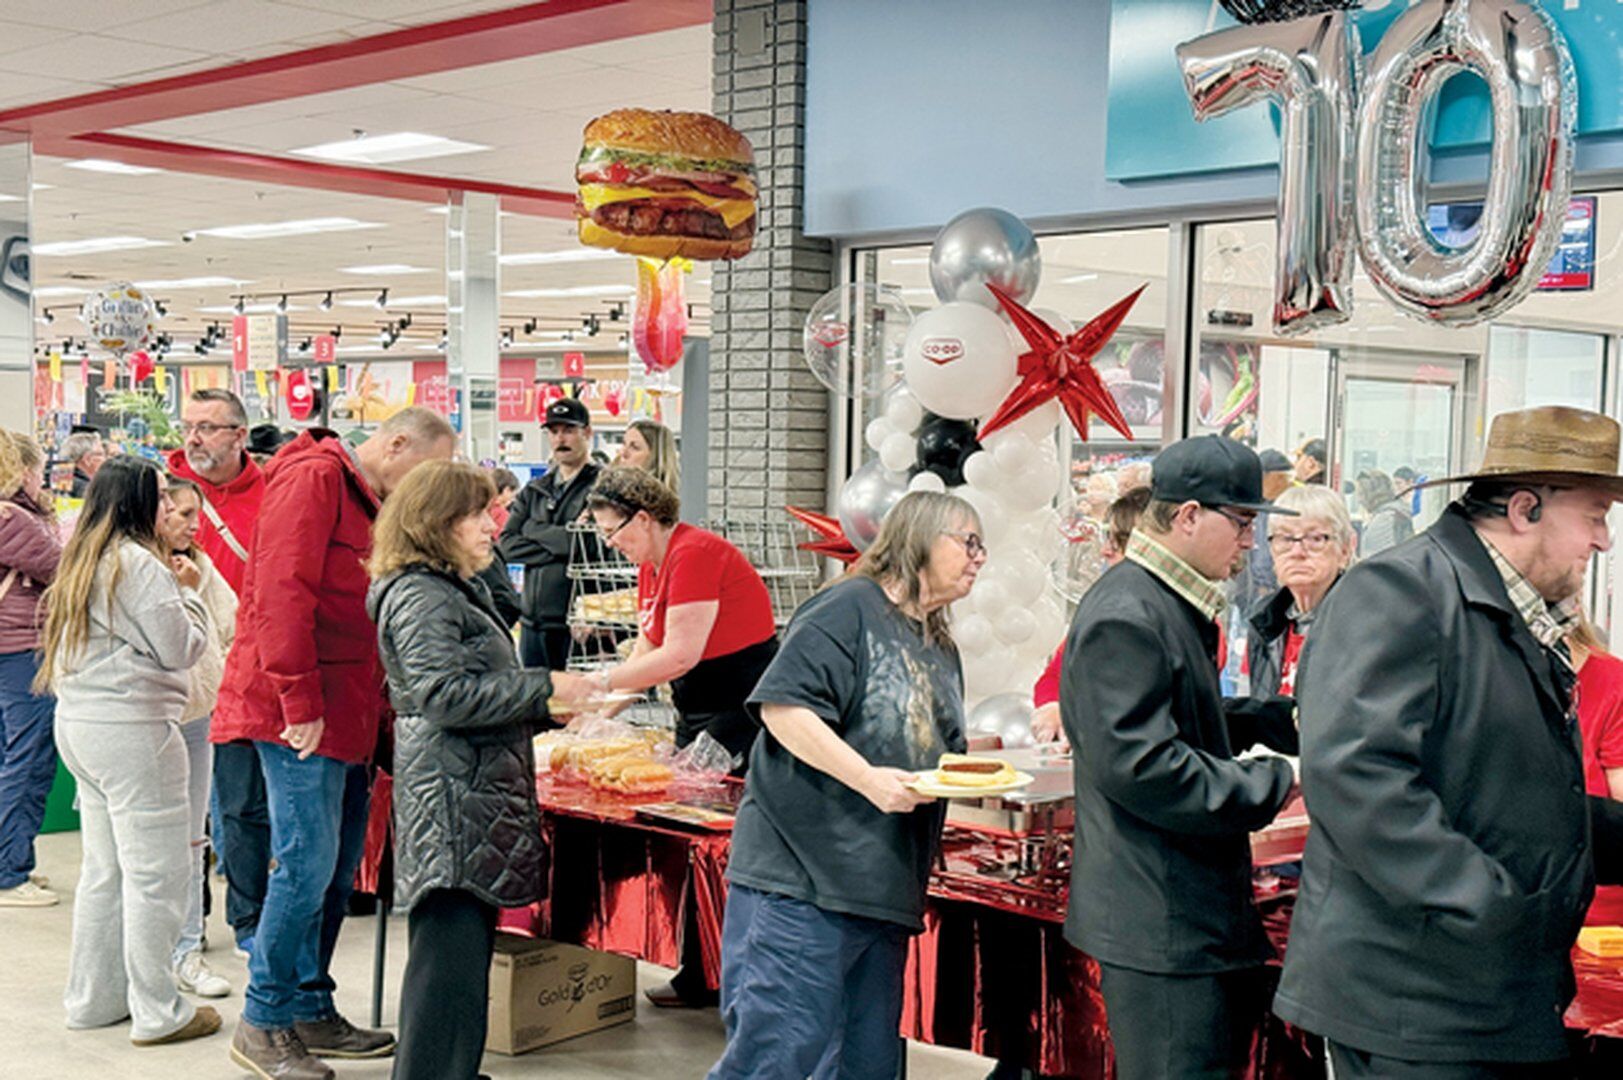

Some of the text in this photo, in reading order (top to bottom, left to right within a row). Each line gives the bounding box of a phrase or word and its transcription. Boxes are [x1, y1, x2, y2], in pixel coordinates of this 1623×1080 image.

[1177, 0, 1578, 336] 70
[234, 335, 242, 352] 1
[320, 341, 329, 357] 3
[570, 358, 578, 372] 4
[538, 982, 570, 1006] Gold
